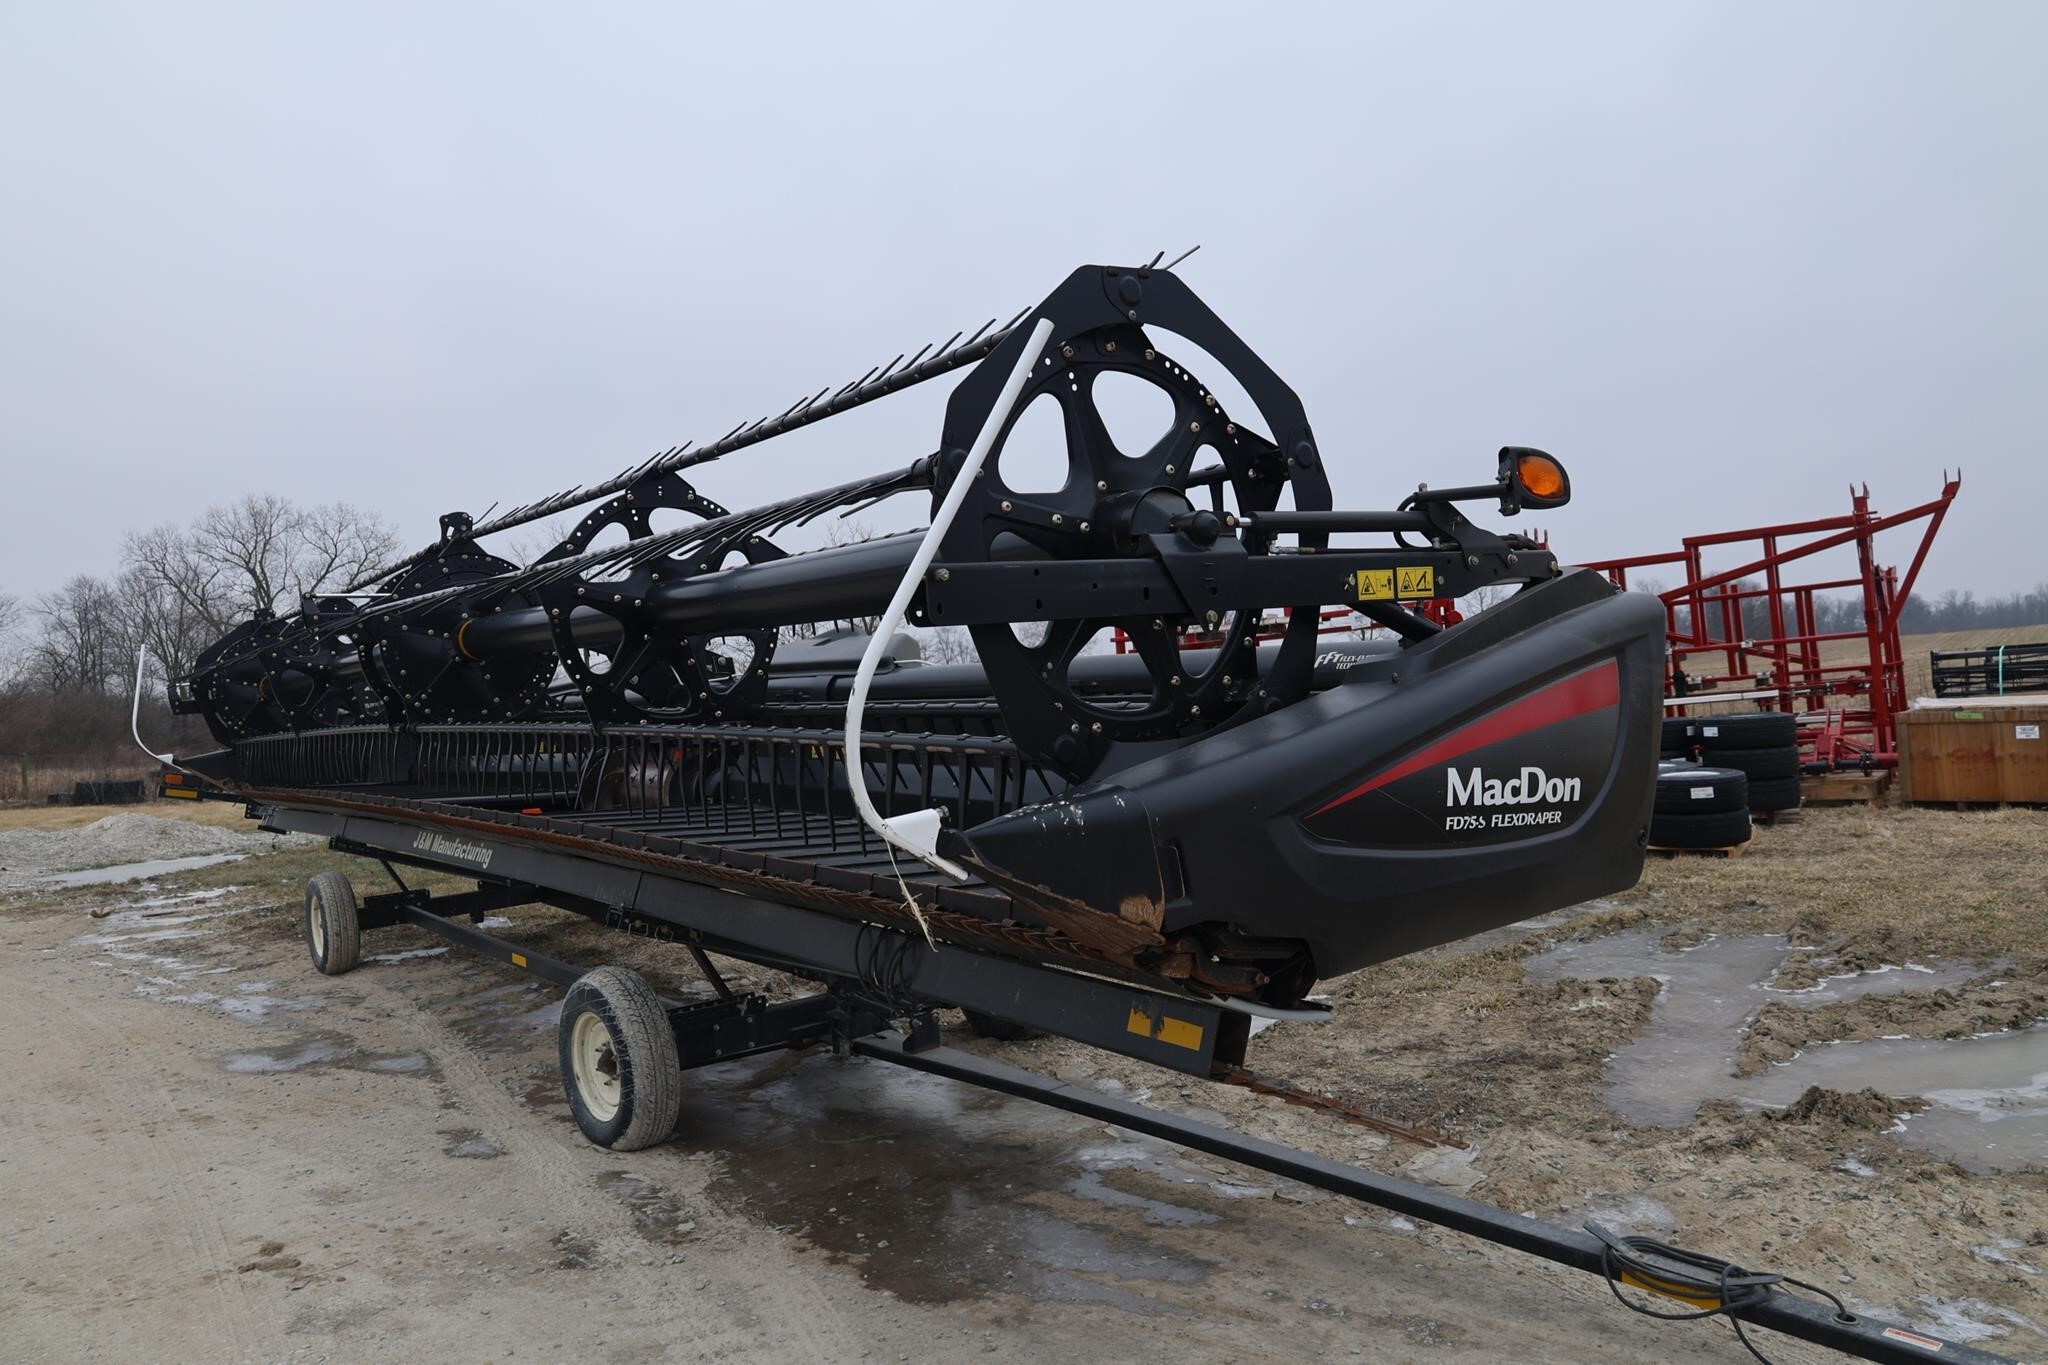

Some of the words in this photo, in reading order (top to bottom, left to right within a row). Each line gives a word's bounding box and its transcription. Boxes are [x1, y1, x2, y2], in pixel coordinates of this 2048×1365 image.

[1446, 766, 1582, 807] MacDon
[1445, 815, 1486, 831] FD75-S
[1491, 811, 1562, 828] FLEXDRAPER
[413, 831, 433, 850] J&M
[431, 834, 494, 869] Manufacturing
